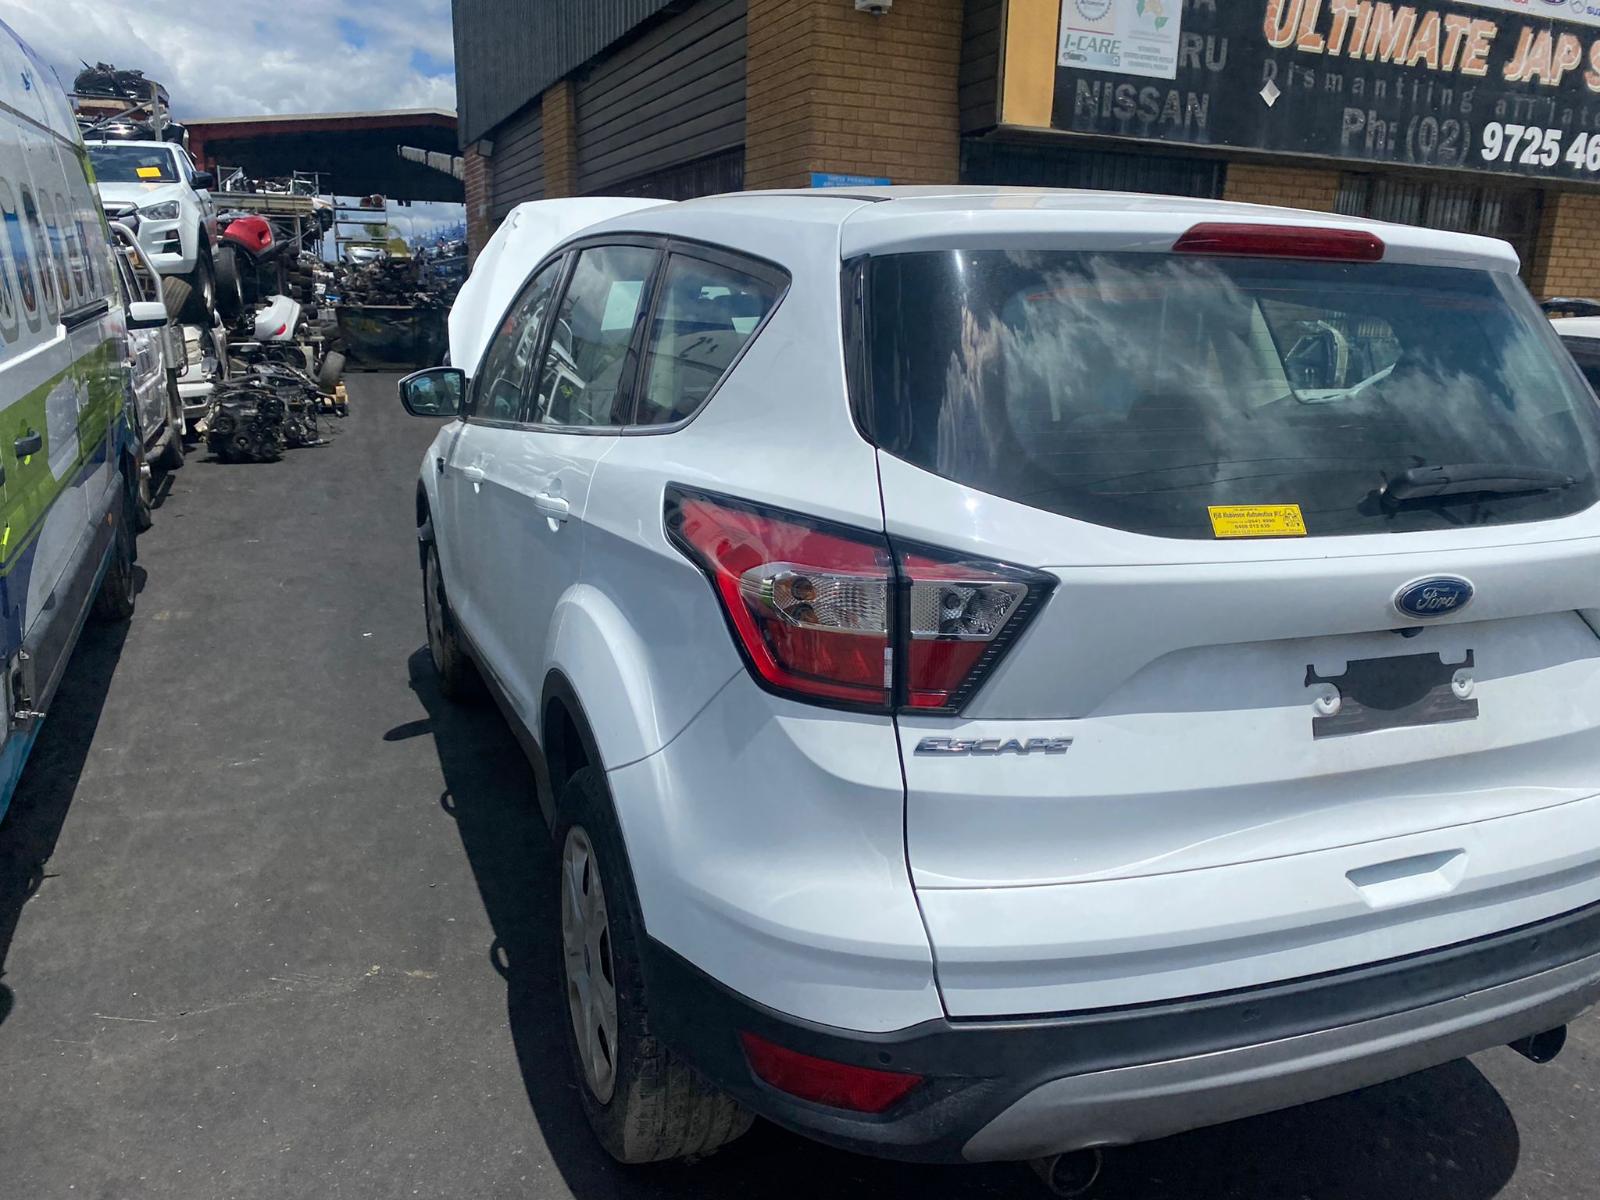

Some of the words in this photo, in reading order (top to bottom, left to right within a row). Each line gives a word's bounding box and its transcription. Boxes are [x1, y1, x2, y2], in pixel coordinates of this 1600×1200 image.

[1064, 34, 1122, 55] I-CARE
[1264, 0, 1497, 76] ULTIMATE
[1074, 78, 1209, 128] NISSAN
[1405, 115, 1471, 164] (02)
[1481, 122, 1562, 167] 9725
[1416, 587, 1459, 610] Ford
[913, 737, 1073, 756] ESCAPE
